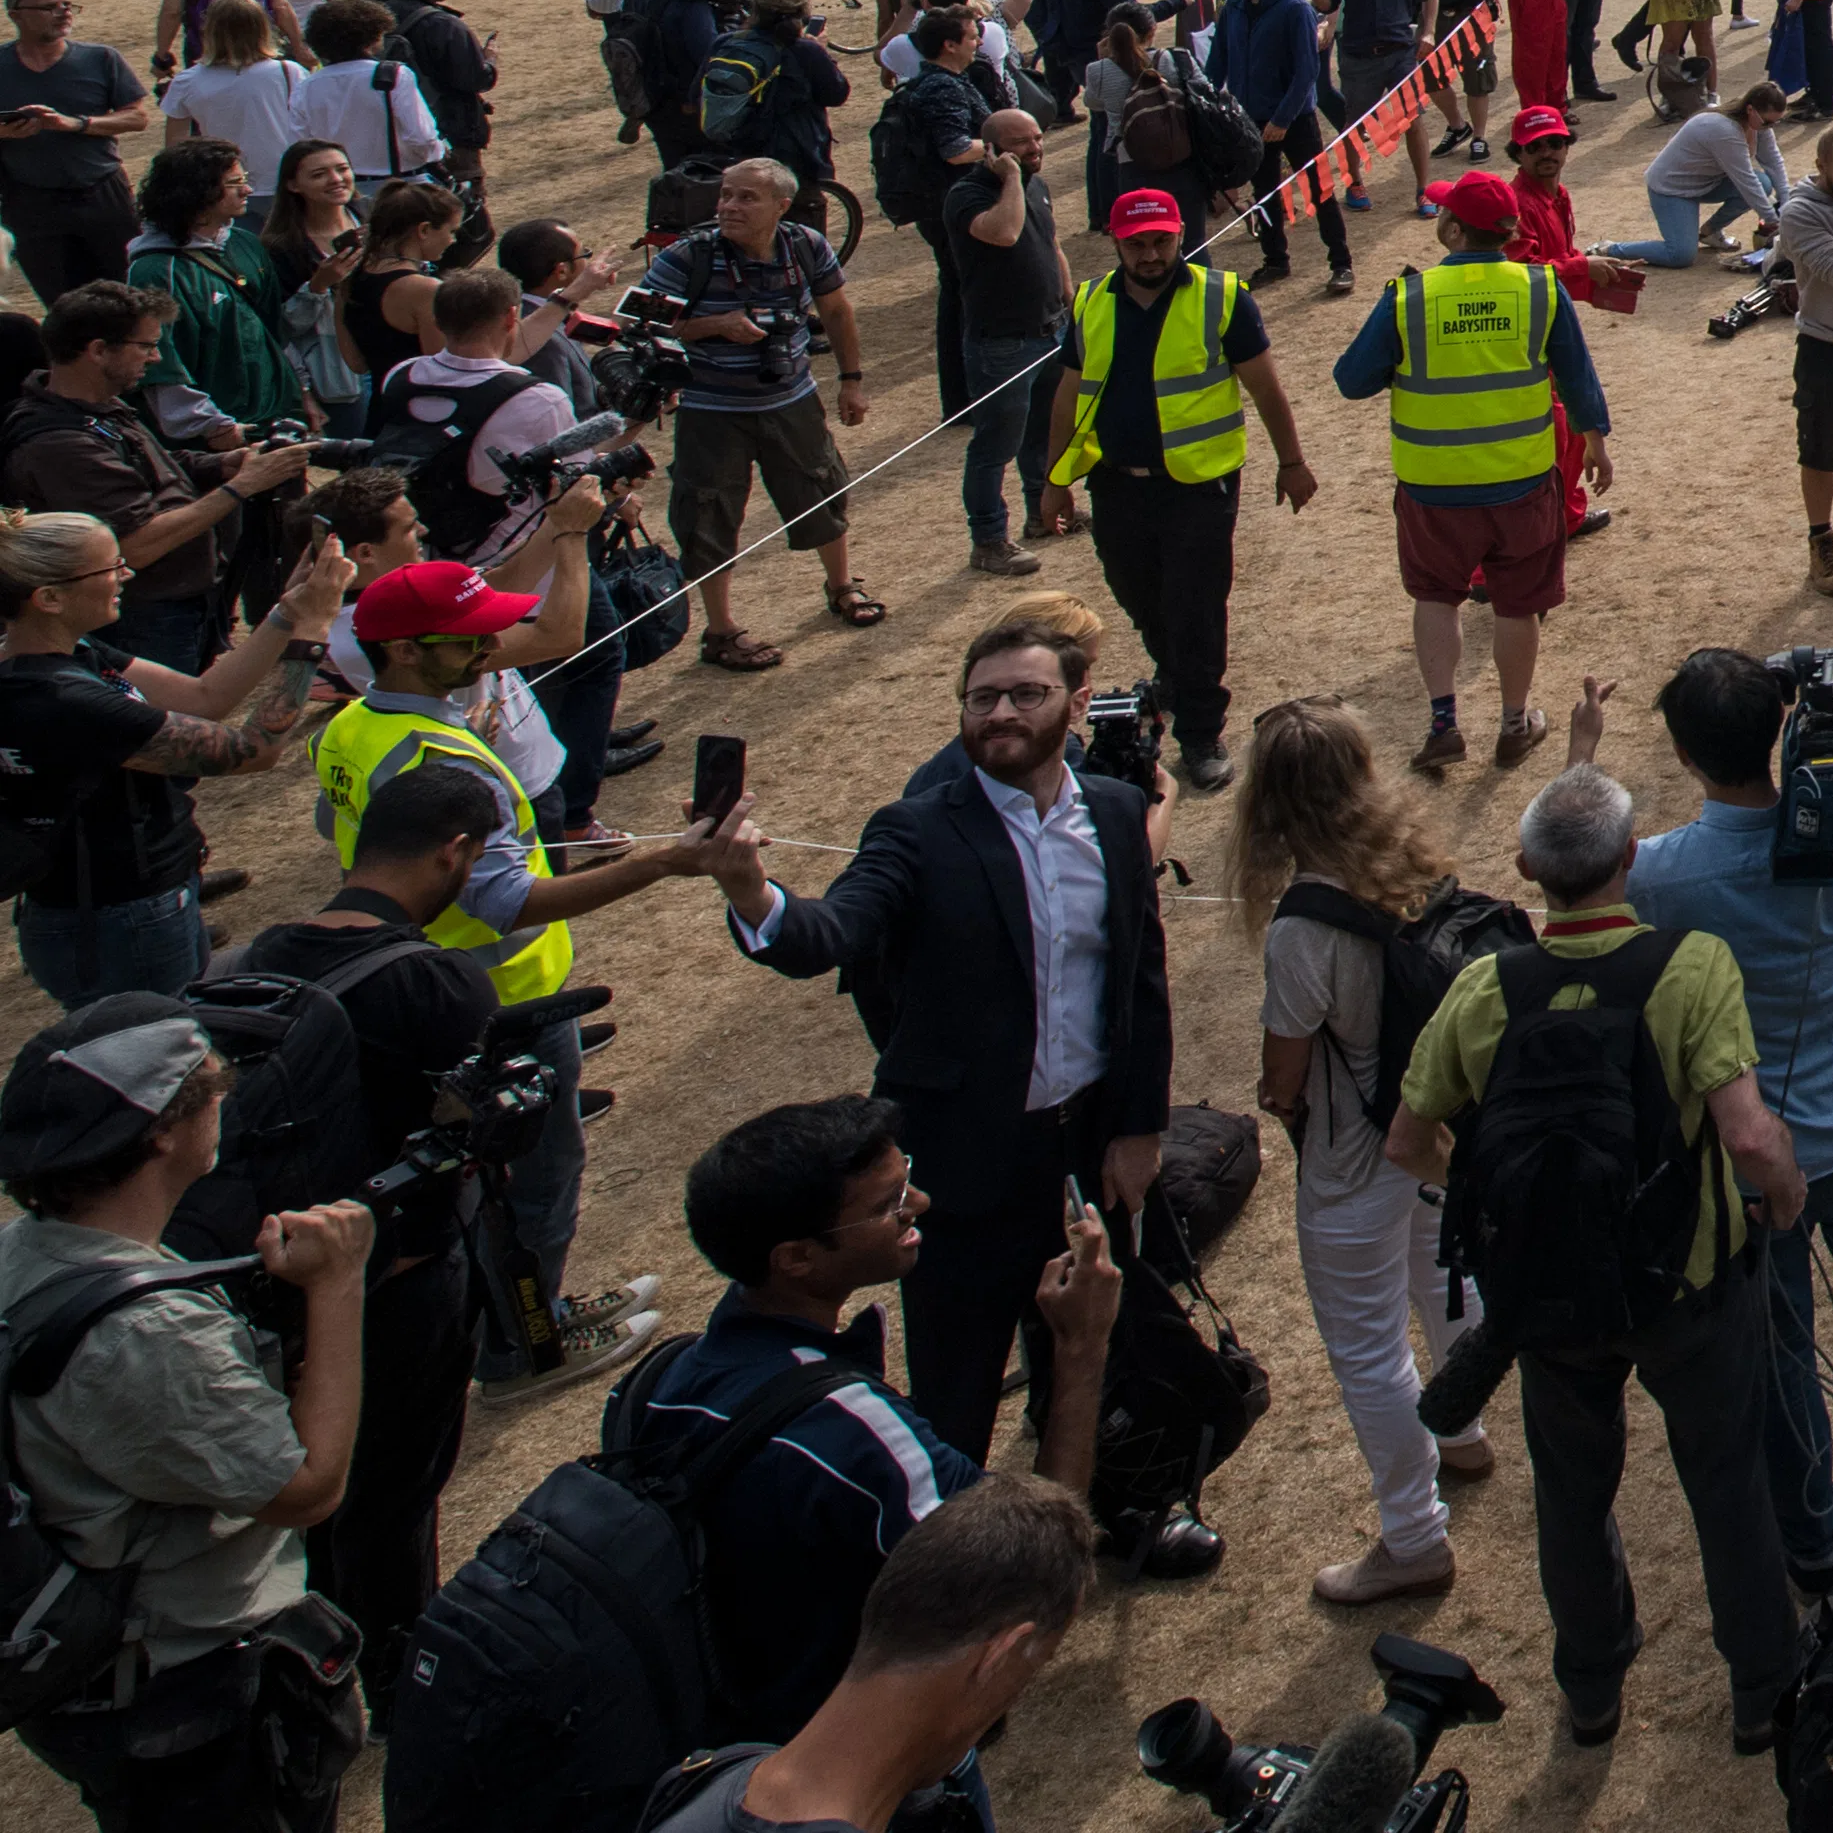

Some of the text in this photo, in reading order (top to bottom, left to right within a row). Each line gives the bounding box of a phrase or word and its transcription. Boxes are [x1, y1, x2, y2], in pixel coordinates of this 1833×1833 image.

[1126, 207, 1168, 216] BABYSITTER
[1135, 201, 1159, 209] TRUMP
[1457, 302, 1497, 317] TRUMP
[1443, 317, 1511, 335] BABYSITTER
[517, 1277, 538, 1312] Nikon
